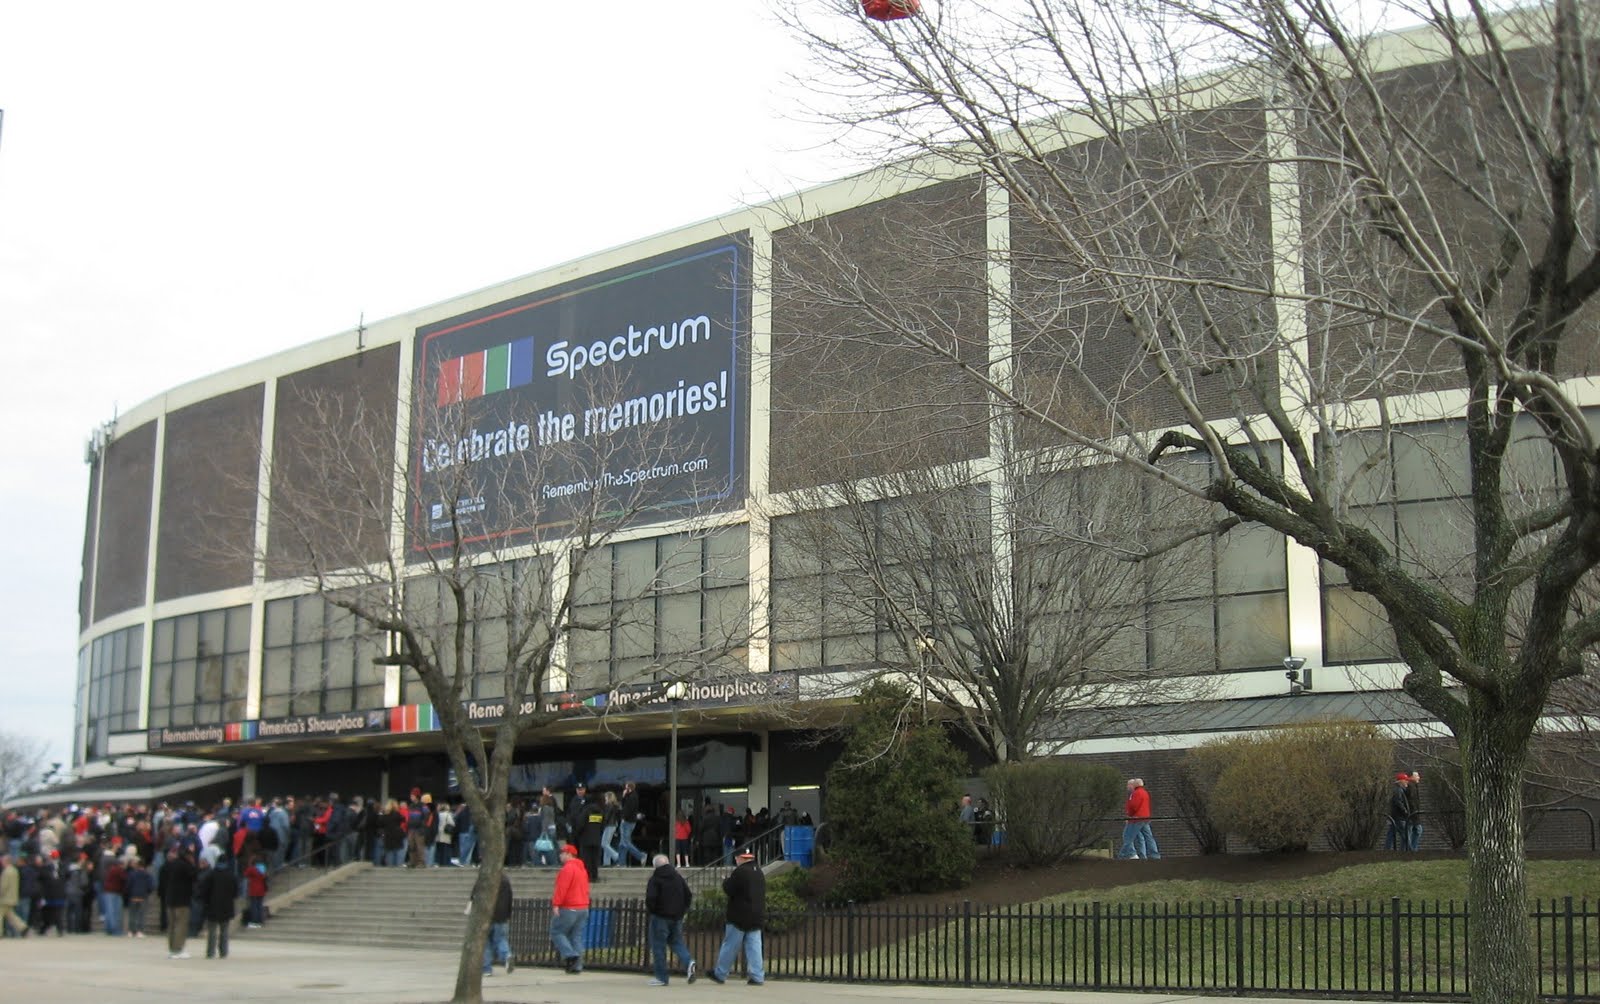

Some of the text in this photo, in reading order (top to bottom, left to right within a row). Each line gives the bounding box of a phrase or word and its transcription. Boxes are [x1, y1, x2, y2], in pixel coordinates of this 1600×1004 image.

[546, 315, 711, 380] Spectrum
[423, 370, 727, 472] Celebrate the memories!
[542, 458, 708, 499] RemembeTheSpectrum.com
[162, 714, 364, 743] Remembering America's Showplace
